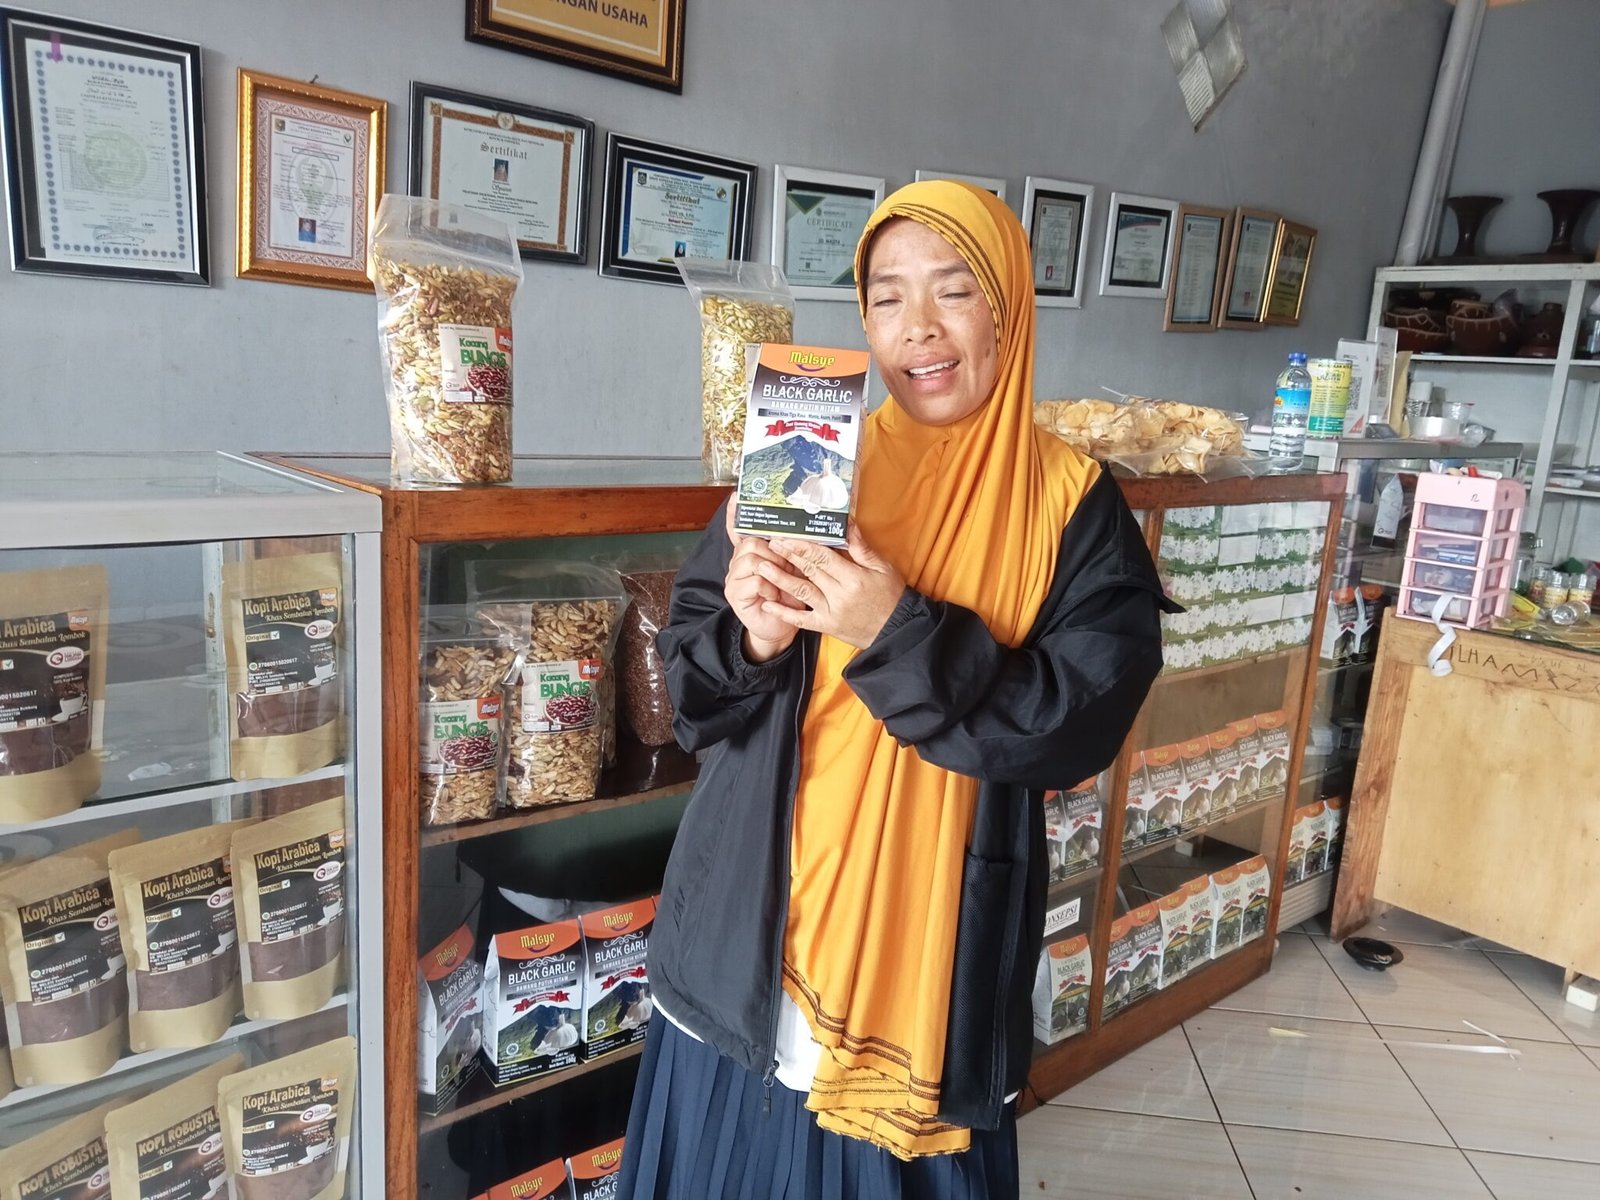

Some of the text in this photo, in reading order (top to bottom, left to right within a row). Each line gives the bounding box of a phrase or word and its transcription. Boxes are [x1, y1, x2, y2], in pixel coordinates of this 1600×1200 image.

[602, 3, 648, 28] USAHA
[459, 338, 488, 350] Kacang
[460, 350, 507, 367] BUNGIS
[789, 351, 834, 367] Malsye
[763, 384, 852, 403] BLACK GARLIC
[771, 401, 840, 413] BAWANG PUTIH HITAM
[828, 524, 844, 537] 100g
[244, 594, 311, 618] Kopi Arabica
[264, 606, 334, 622] Khas Sembalun Lombok
[4, 619, 56, 638] Arabica
[246, 633, 271, 642] Original
[19, 635, 57, 647] Sembalun
[58, 631, 86, 642] Lombok
[540, 673, 570, 682] Kacang
[540, 681, 591, 698] BUNGIS
[433, 714, 467, 723] Kacang
[433, 721, 489, 739] BUNGIS
[1067, 793, 1097, 810] BLACK GARLIC
[1045, 806, 1059, 816] ARLIC
[256, 841, 320, 869] Kopi Arabica
[276, 862, 293, 872] Khas
[293, 853, 322, 868] Sembalun
[144, 866, 214, 898] Kopi Arabica
[165, 890, 184, 901] Khas
[185, 880, 216, 896] Sembalun
[21, 887, 100, 923] Kopi Arabica
[46, 900, 102, 925] Khas Sembalun
[602, 911, 634, 928] Malsye
[26, 937, 55, 948] Original
[520, 932, 555, 949] Malsye
[1134, 931, 1148, 942] BLACK
[435, 942, 459, 967] Malsye
[594, 938, 649, 964] BLACK GARLI
[508, 960, 576, 986] BLACK GARLIC
[438, 962, 479, 1007] BLACK GARLIC
[516, 975, 569, 992] BAWANG PUTIH HITAM
[243, 1085, 311, 1111] Kopi Arabica
[261, 1105, 280, 1114] Khas
[280, 1098, 311, 1110] Sembalun
[137, 1109, 214, 1157] KOPI ROBUSTA
[158, 1129, 207, 1156] Khas Sembalun
[591, 1147, 622, 1167] Malsye
[20, 1139, 103, 1196] KOPI ROBUSTA
[43, 1162, 95, 1194] Khas Sembalun
[510, 1176, 543, 1198] Malsye
[583, 1183, 612, 1200] BLACK
